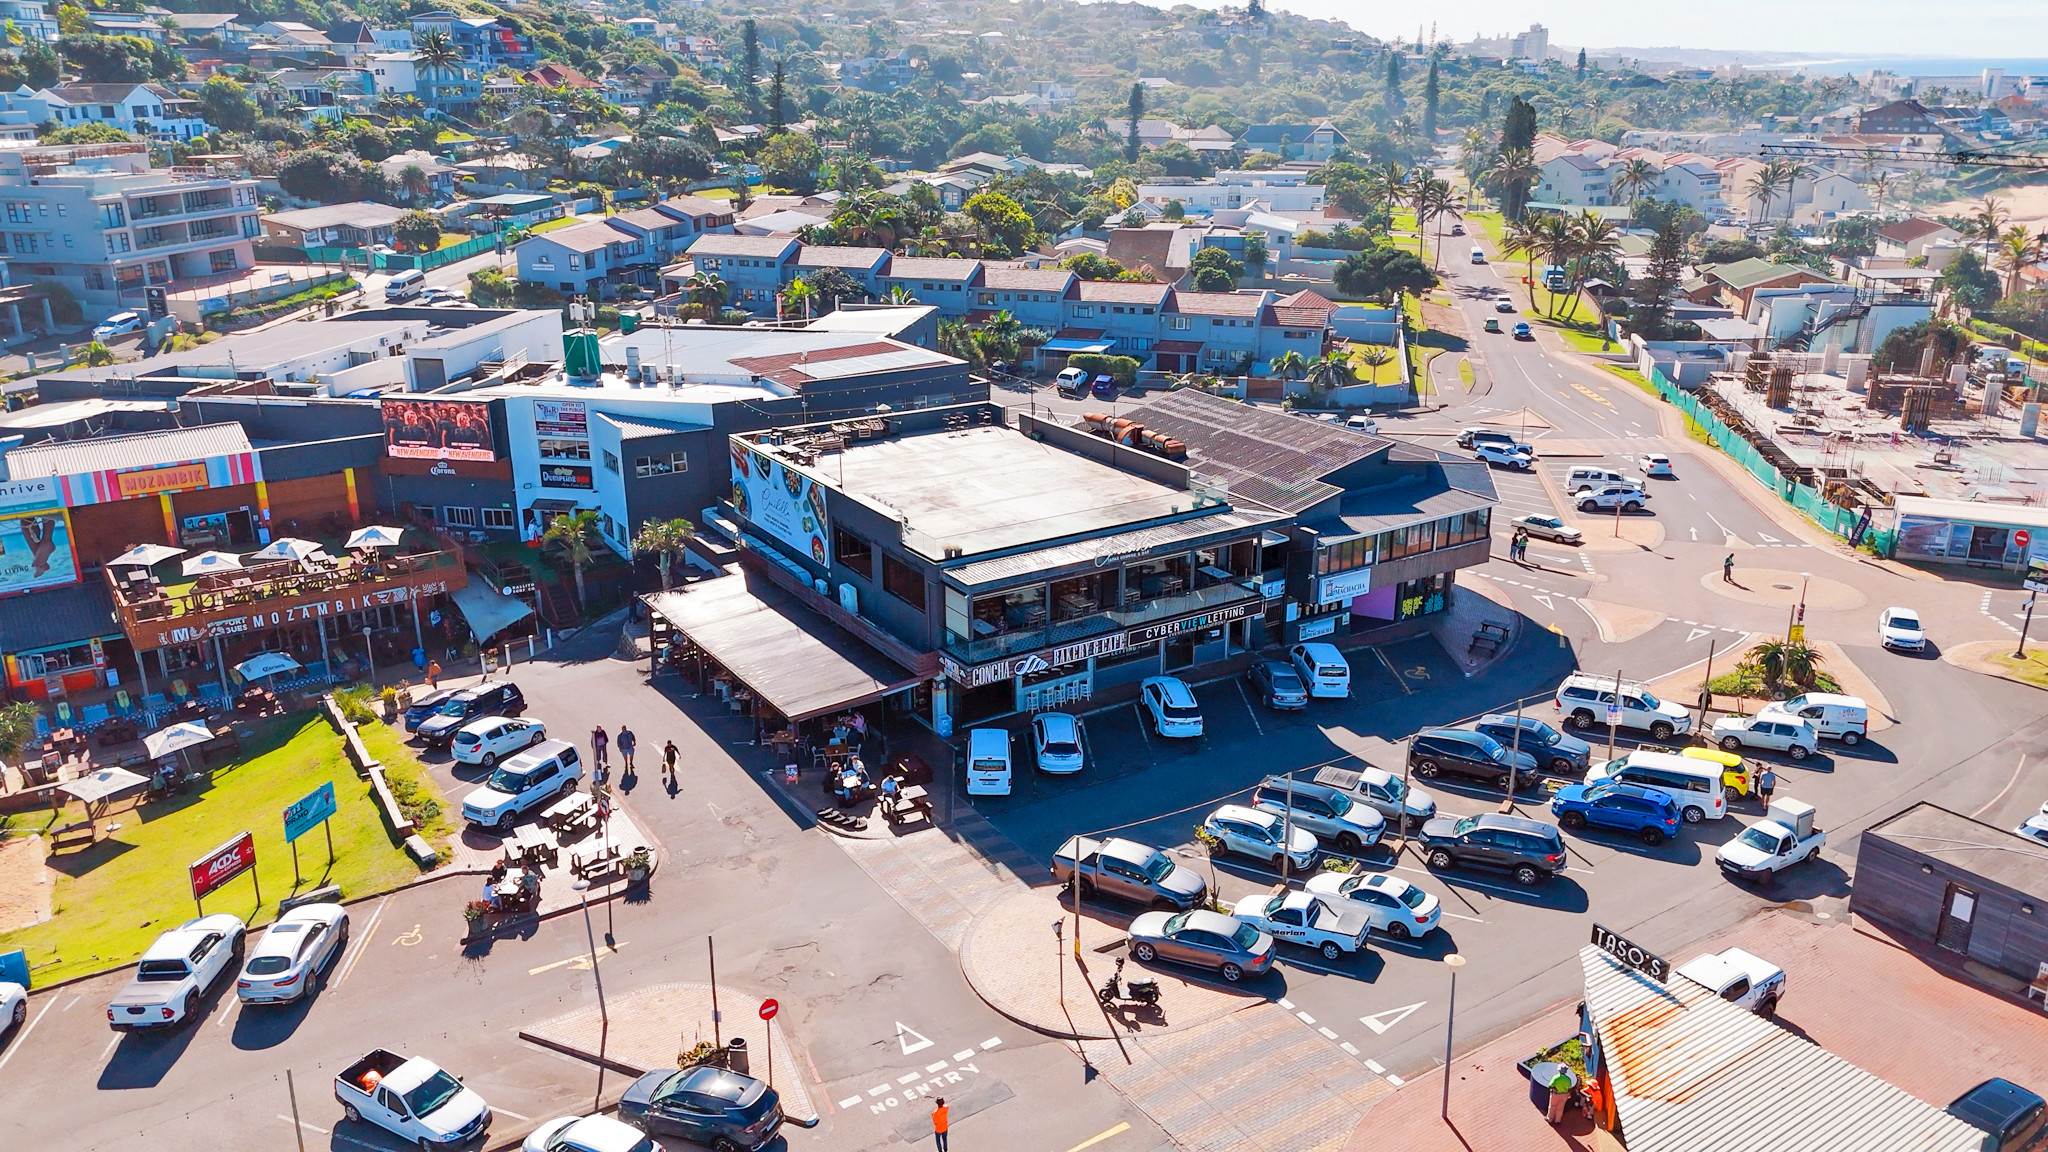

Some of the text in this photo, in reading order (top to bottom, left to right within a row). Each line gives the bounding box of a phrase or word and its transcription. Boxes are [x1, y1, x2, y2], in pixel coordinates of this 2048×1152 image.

[124, 469, 203, 491] MOZAMBIK
[430, 466, 456, 476] Corona
[253, 595, 371, 628] MOZAMBIK
[1053, 642, 1091, 666] BAKERY
[262, 663, 286, 673] Corona
[972, 661, 1010, 687] CONCHA
[208, 847, 241, 876] ACDC
[869, 1063, 981, 1115] NO ENTRY
